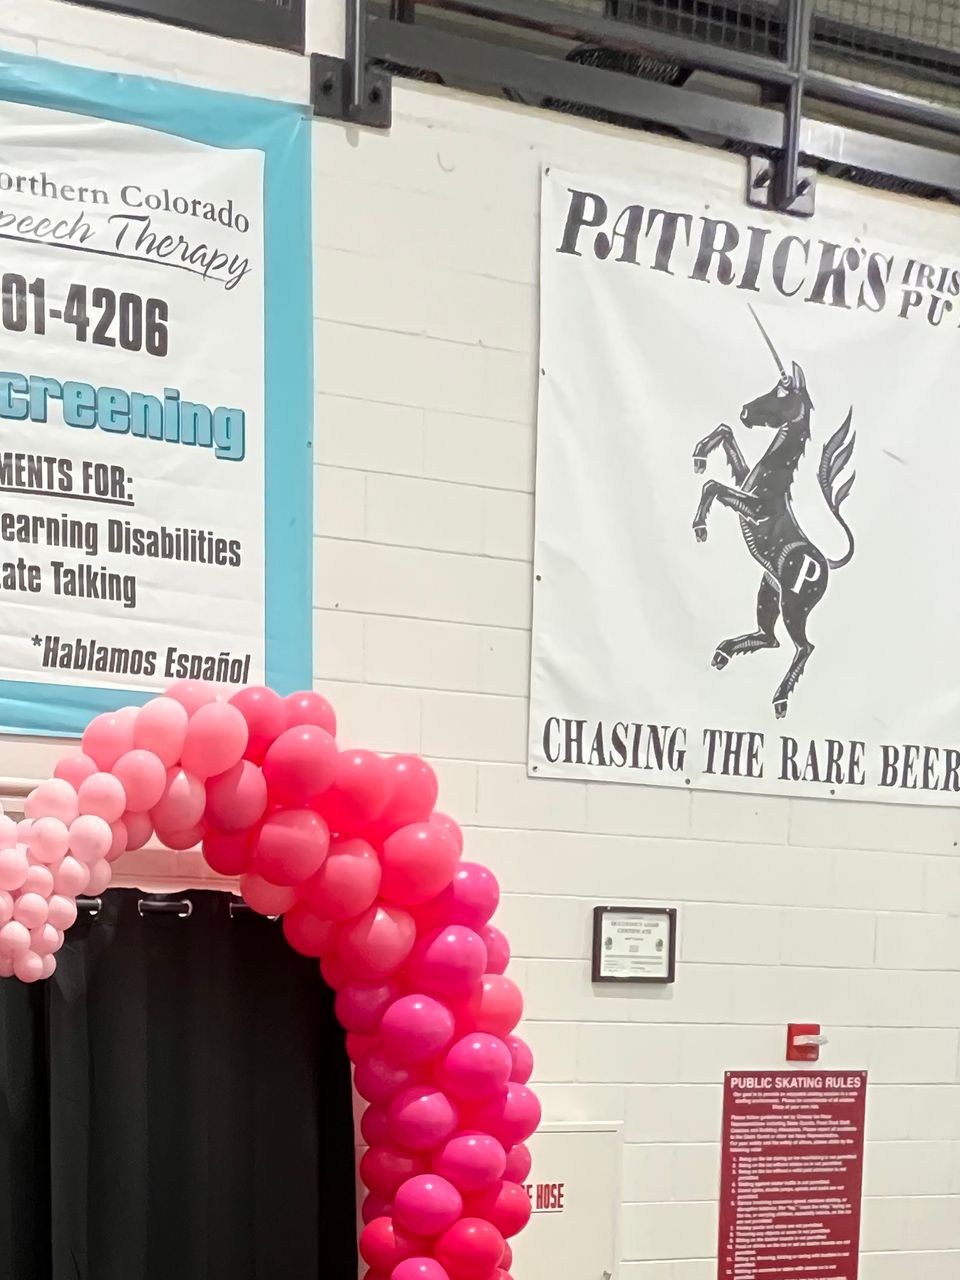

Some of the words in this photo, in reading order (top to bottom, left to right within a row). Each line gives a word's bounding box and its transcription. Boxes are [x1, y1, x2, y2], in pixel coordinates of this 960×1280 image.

[121, 185, 250, 234] Colorado
[108, 214, 253, 290] Therapy
[897, 288, 960, 327] PU
[82, 463, 135, 501] FOR:
[108, 520, 241, 567] Disabilities
[51, 561, 137, 608] Talking
[792, 555, 822, 593] P
[165, 647, 251, 685] Español
[542, 716, 688, 772] CHASING
[703, 729, 765, 777] THE
[777, 736, 866, 785] RARE
[878, 744, 960, 792] BEER
[730, 1077, 772, 1089] PUBLIC
[775, 1077, 823, 1088] SKATING
[825, 1077, 861, 1088] RULES
[536, 1183, 564, 1209] HOSE
